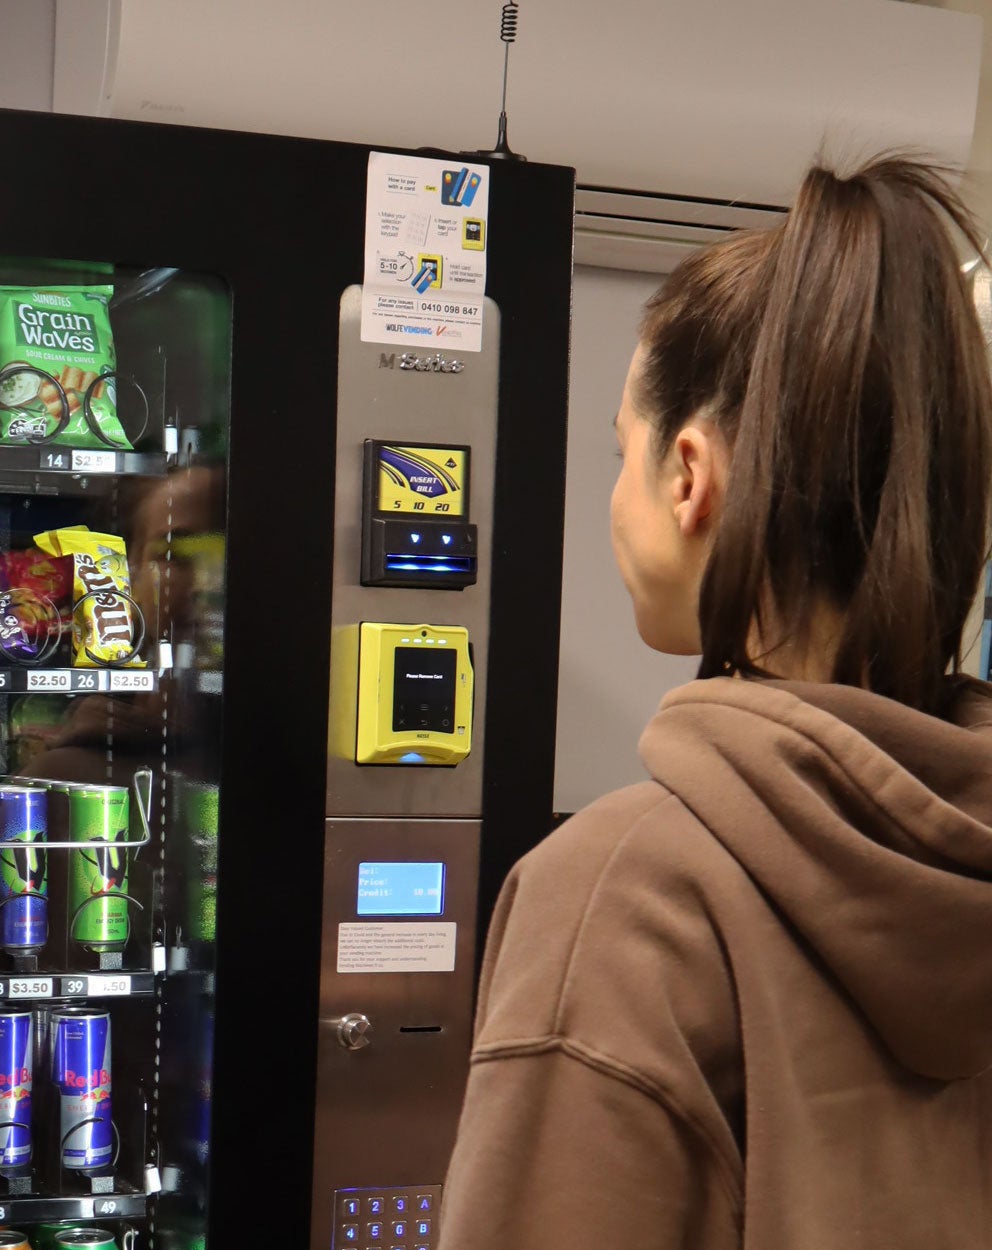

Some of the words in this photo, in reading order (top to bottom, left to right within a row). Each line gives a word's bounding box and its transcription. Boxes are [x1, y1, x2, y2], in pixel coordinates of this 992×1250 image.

[32, 293, 72, 308] SUNBITES
[421, 302, 442, 312] 0410
[444, 305, 460, 314] 098
[462, 306, 478, 316] 847
[18, 303, 91, 331] Grain
[47, 455, 64, 468] 14
[410, 476, 438, 484] INSERT
[394, 500, 401, 509] 5
[413, 501, 425, 511] 10
[435, 502, 450, 512] 20
[77, 675, 94, 688] 26
[113, 675, 149, 687] $2.50
[67, 980, 83, 994] 39
[64, 1069, 98, 1087] Red
[100, 1200, 117, 1214] 49
